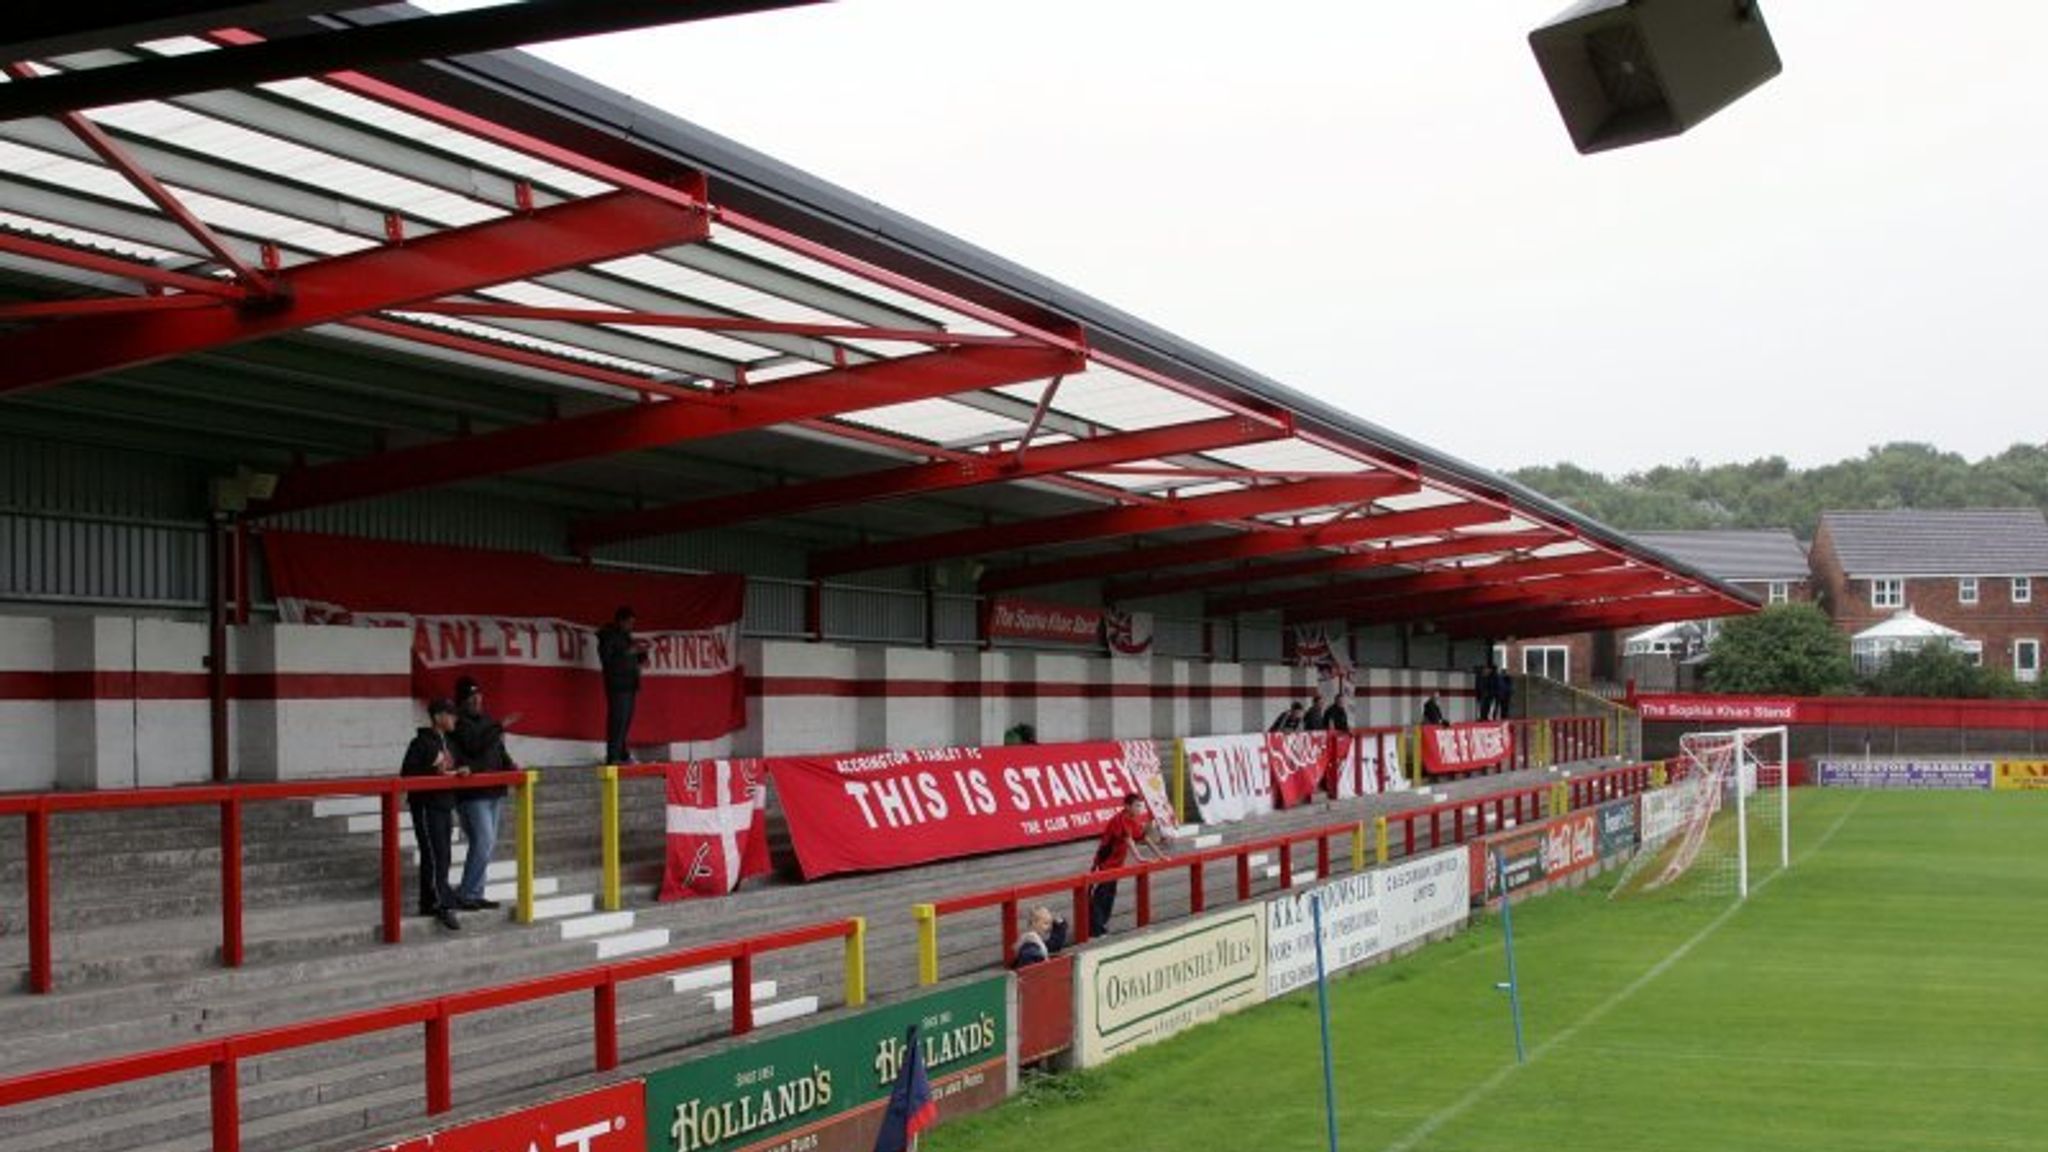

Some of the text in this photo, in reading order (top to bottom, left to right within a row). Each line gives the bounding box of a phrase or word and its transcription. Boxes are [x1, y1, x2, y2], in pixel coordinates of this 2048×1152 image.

[1642, 704, 1792, 718] The Sophia Khan Stand
[845, 758, 1139, 828] THIS IS STANLEY
[1020, 820, 1042, 836] THE
[1215, 936, 1251, 973] MILLS
[671, 1064, 832, 1152] HOLLAND'S
